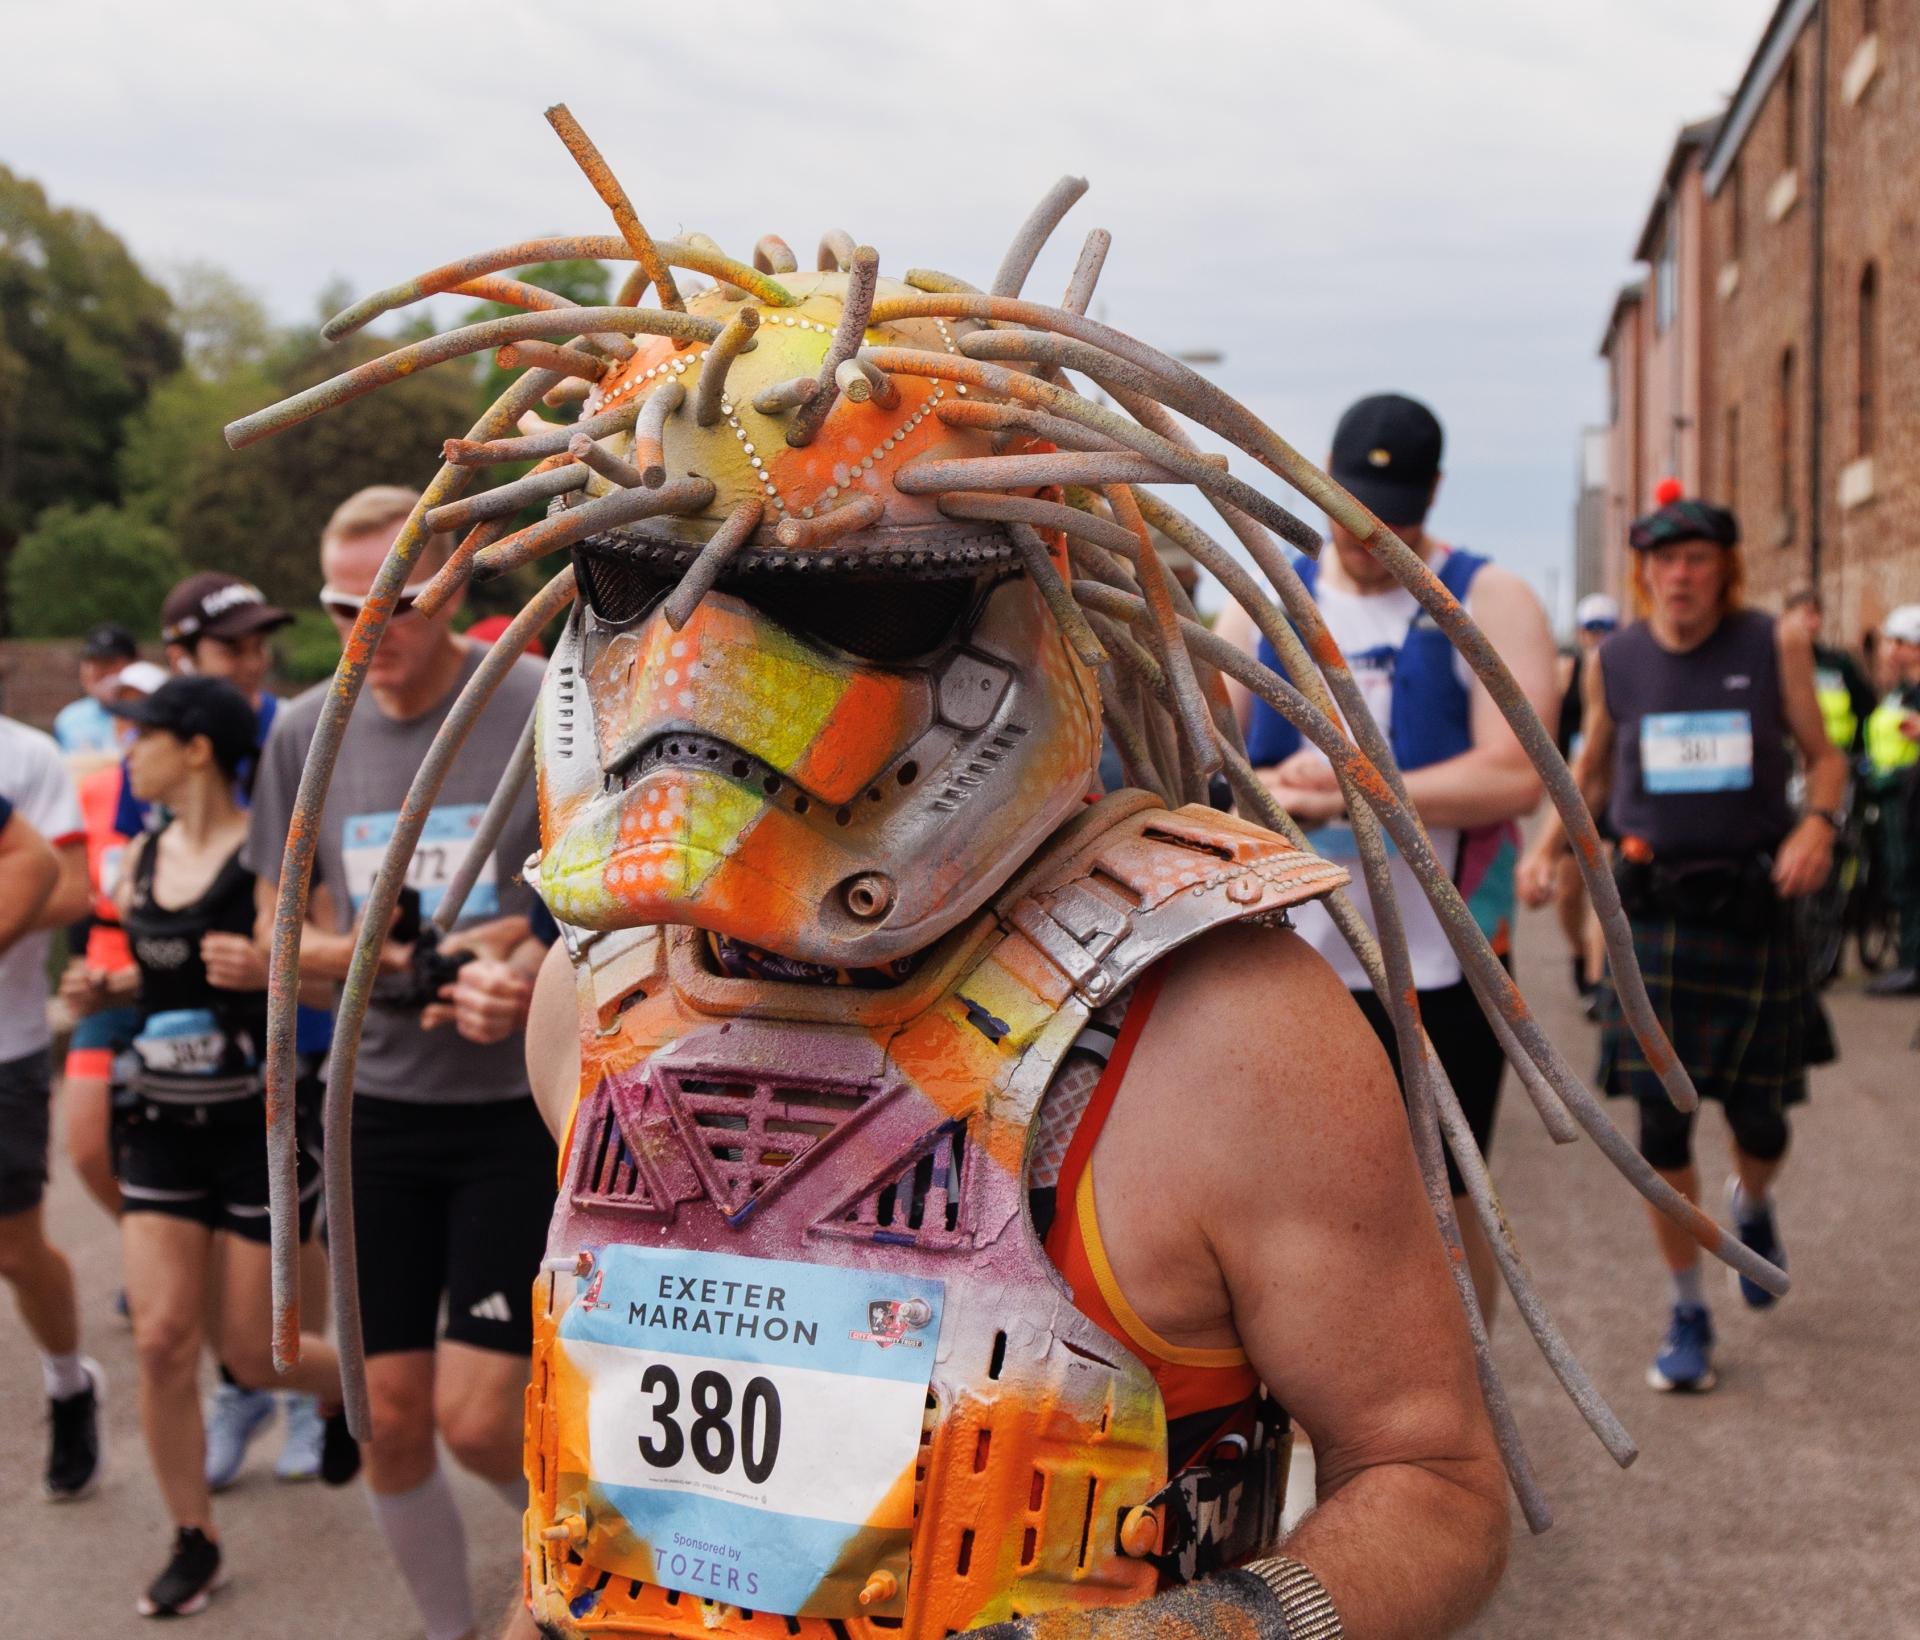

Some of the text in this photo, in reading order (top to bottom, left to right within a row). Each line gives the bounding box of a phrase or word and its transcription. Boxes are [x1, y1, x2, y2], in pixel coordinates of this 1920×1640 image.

[658, 1275, 786, 1312] EXETER
[628, 1301, 819, 1346] MARATHON
[638, 1364, 782, 1485] 380
[673, 1532, 741, 1562] Sponsored by
[655, 1548, 759, 1595] TOZERS
